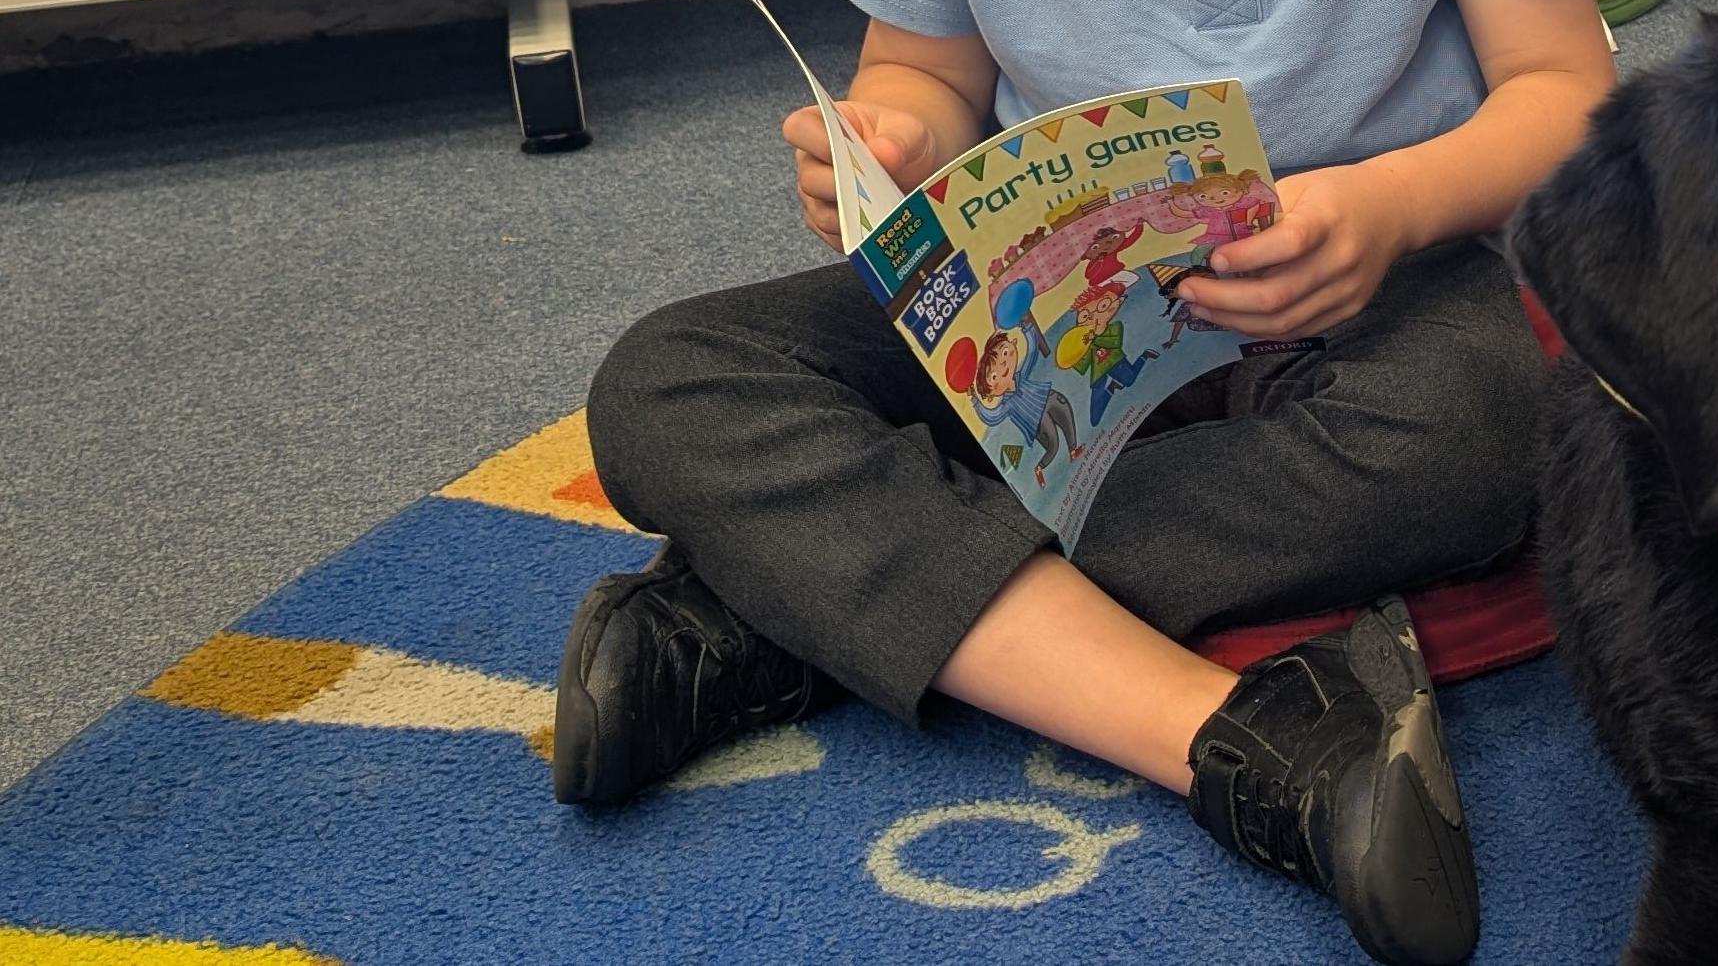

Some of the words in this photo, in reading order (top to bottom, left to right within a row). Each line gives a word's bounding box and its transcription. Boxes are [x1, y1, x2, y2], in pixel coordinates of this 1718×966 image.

[959, 152, 1075, 230] Party
[1086, 120, 1222, 168] games
[876, 207, 913, 247] Read
[884, 219, 922, 257] Write
[897, 240, 932, 281] Phonics
[914, 265, 957, 317] BOOK
[926, 282, 956, 322] BAG
[924, 282, 971, 343] BOOKS
[1252, 340, 1313, 353] OXFORD
[865, 798, 1143, 910] Q
